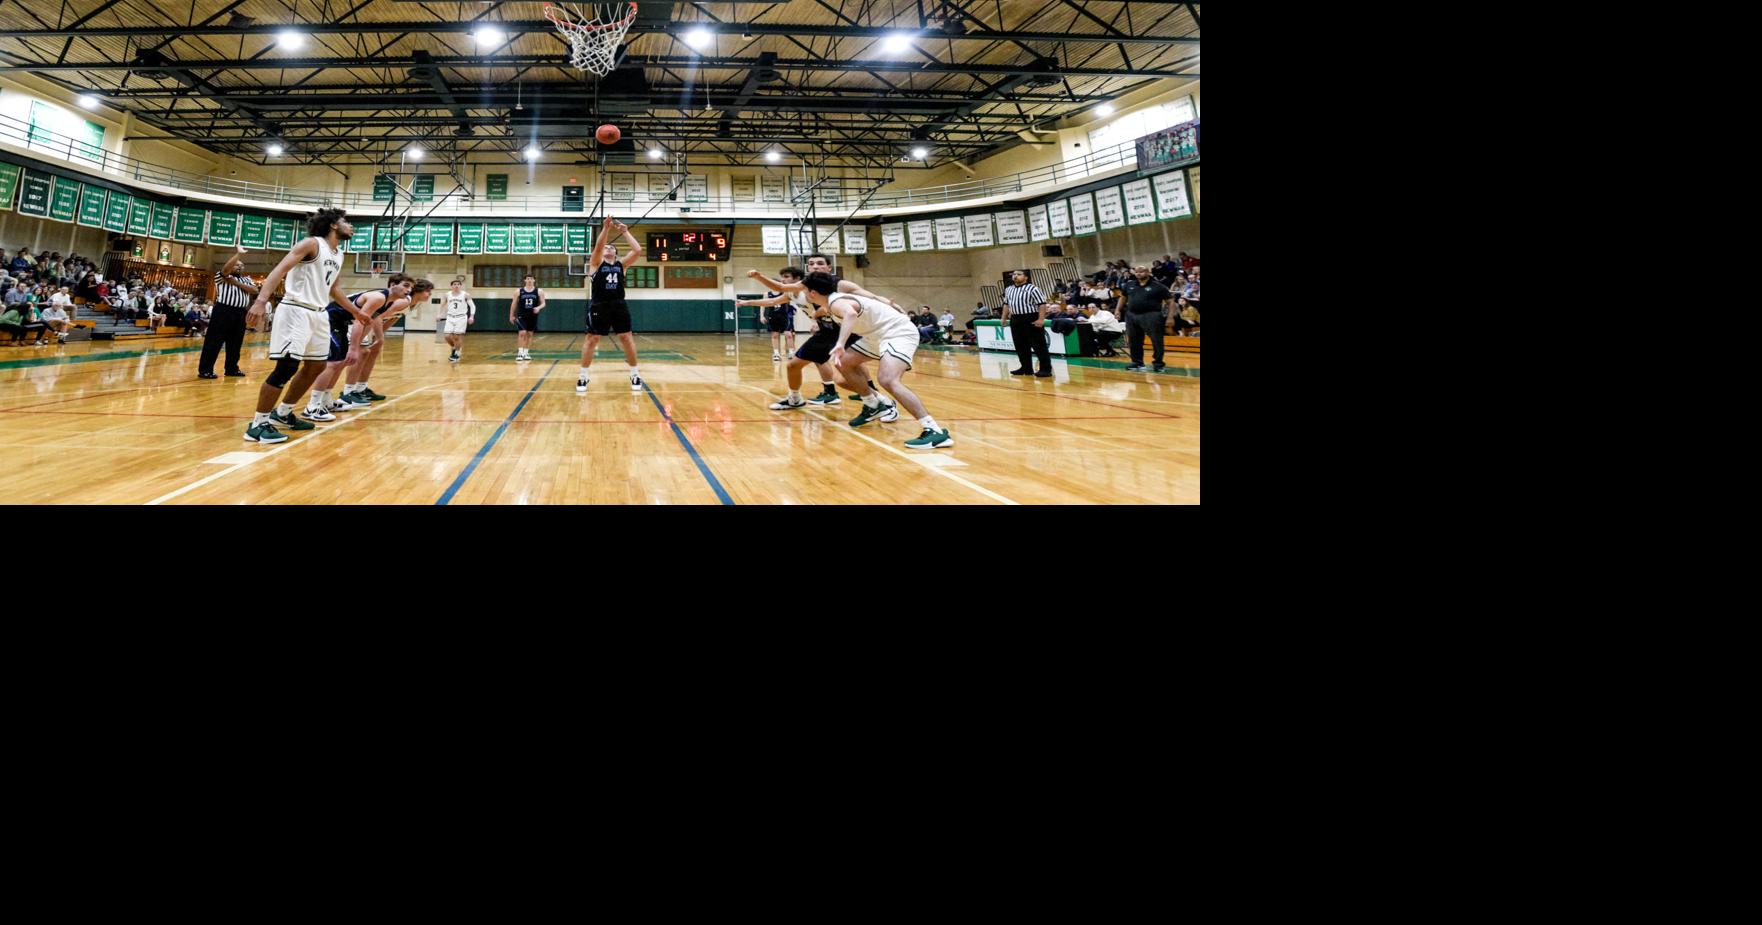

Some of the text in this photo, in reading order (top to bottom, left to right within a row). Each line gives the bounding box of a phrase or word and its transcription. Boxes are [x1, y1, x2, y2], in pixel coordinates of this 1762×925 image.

[1162, 206, 1185, 214] NEWMAN
[656, 238, 666, 248] 11
[717, 238, 726, 248] 9
[606, 273, 618, 283] 44
[725, 312, 734, 320] N
[995, 326, 1005, 340] N
